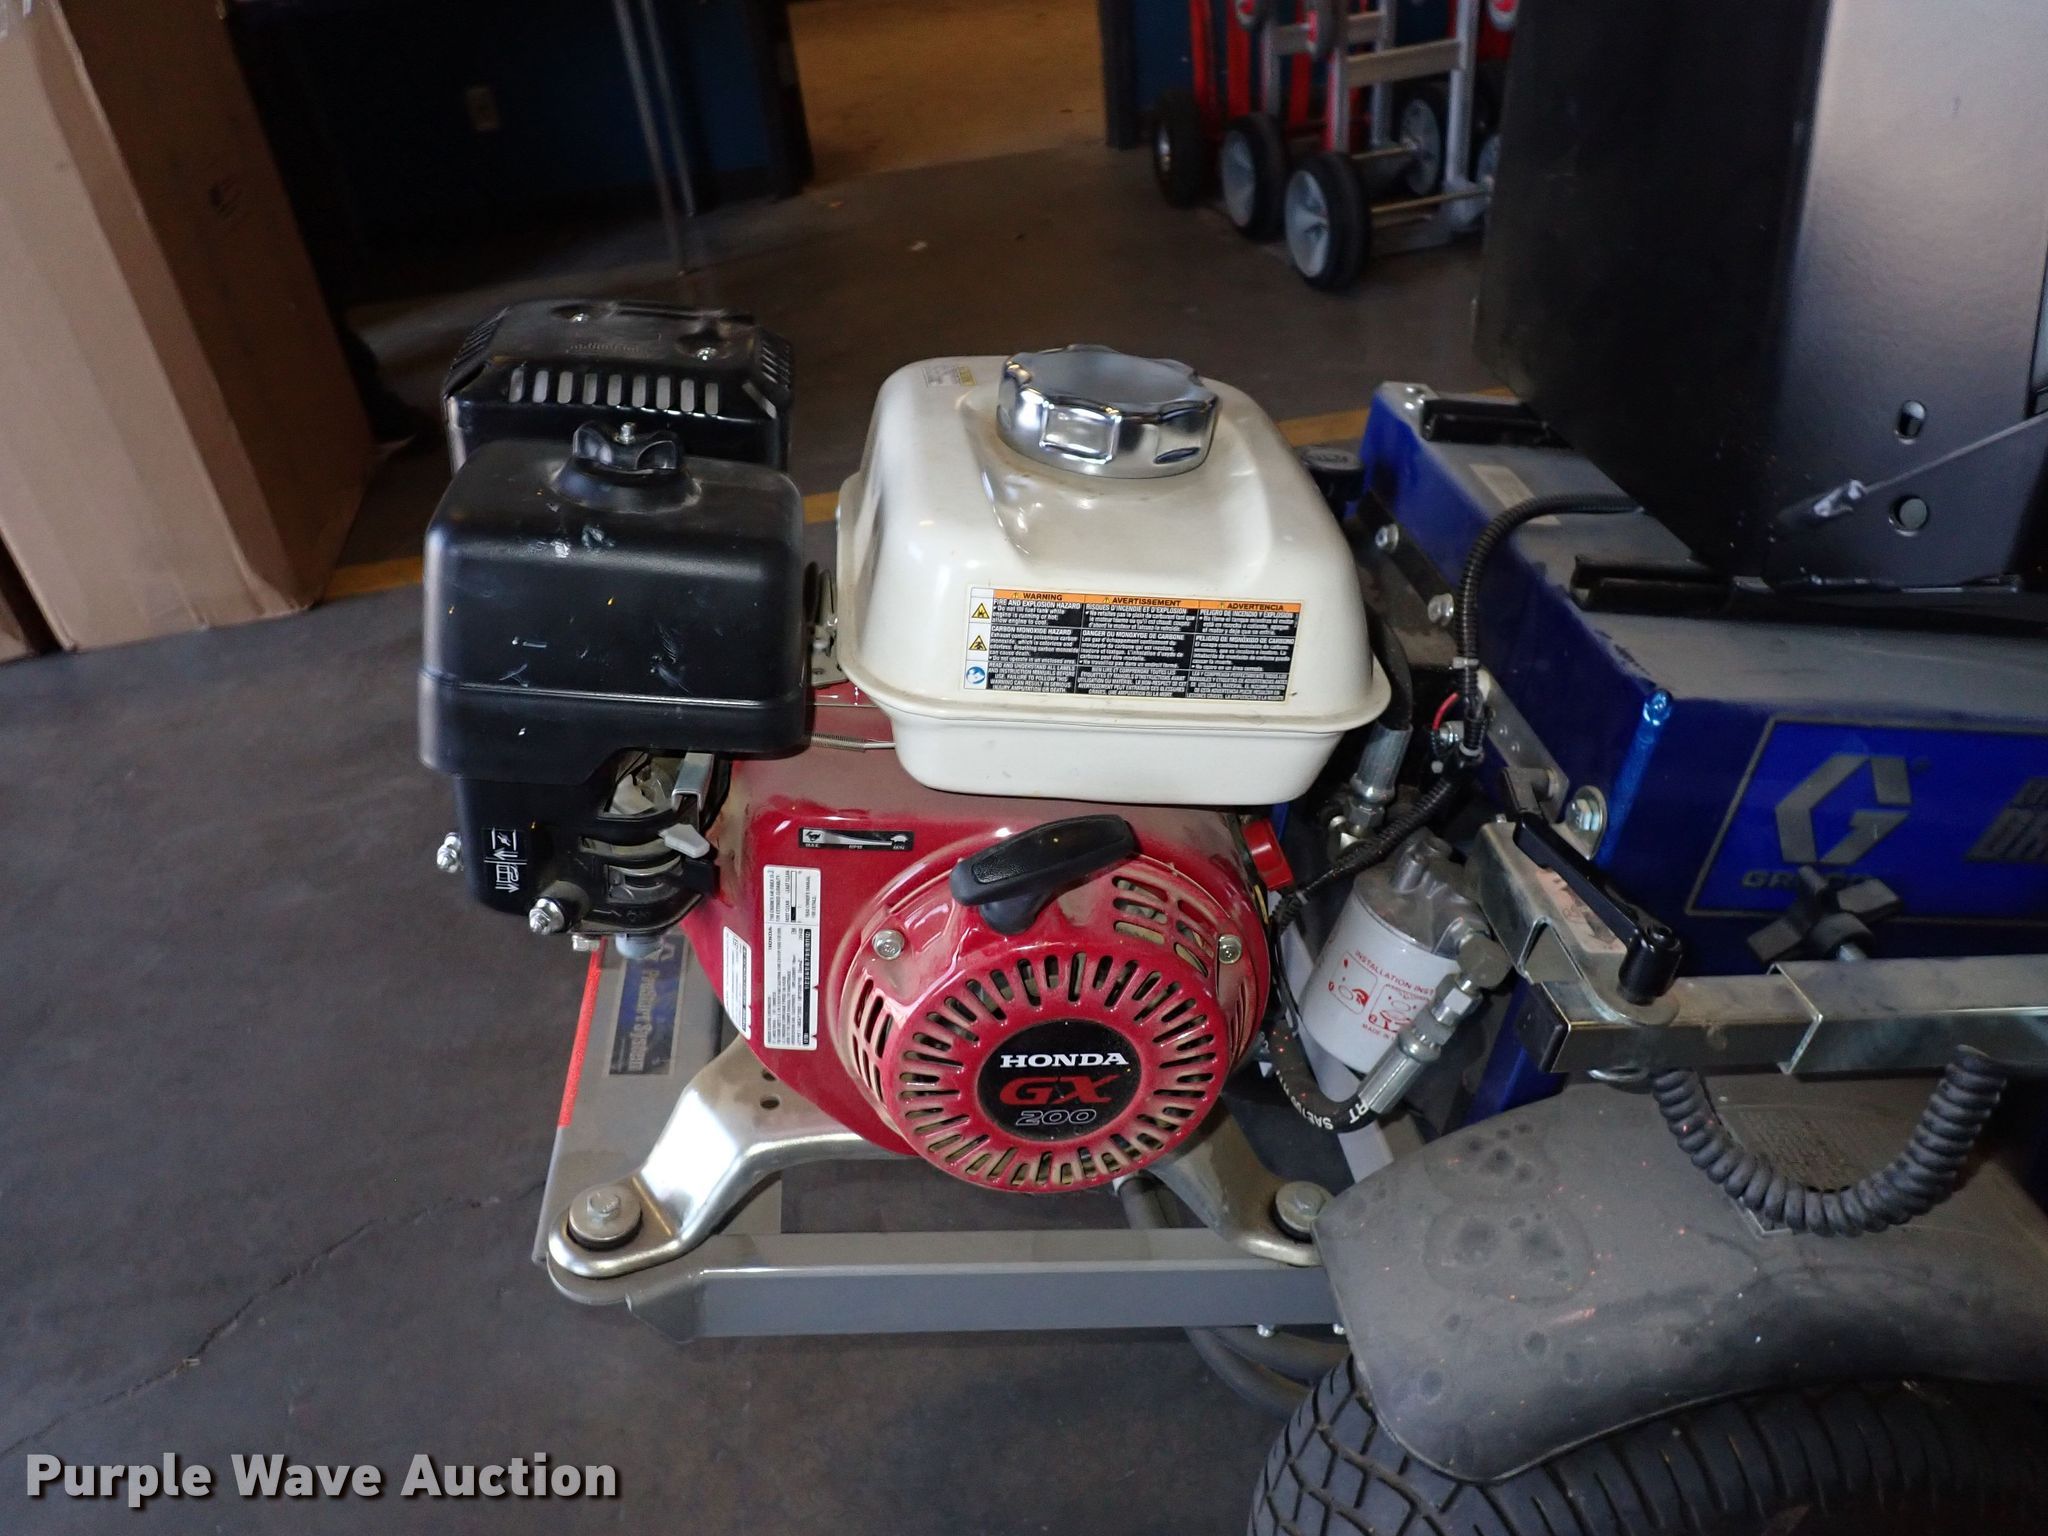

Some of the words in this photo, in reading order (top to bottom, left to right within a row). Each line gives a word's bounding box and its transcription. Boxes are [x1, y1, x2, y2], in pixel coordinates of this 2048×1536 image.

[1112, 597, 1180, 606] AVERTISSEMENT
[1227, 602, 1284, 610] ADVERTENCIA
[1354, 950, 1412, 989] INSTALLATION
[1000, 1053, 1129, 1068] HONDA
[1000, 1074, 1120, 1105] GX
[1016, 1109, 1097, 1126] 200
